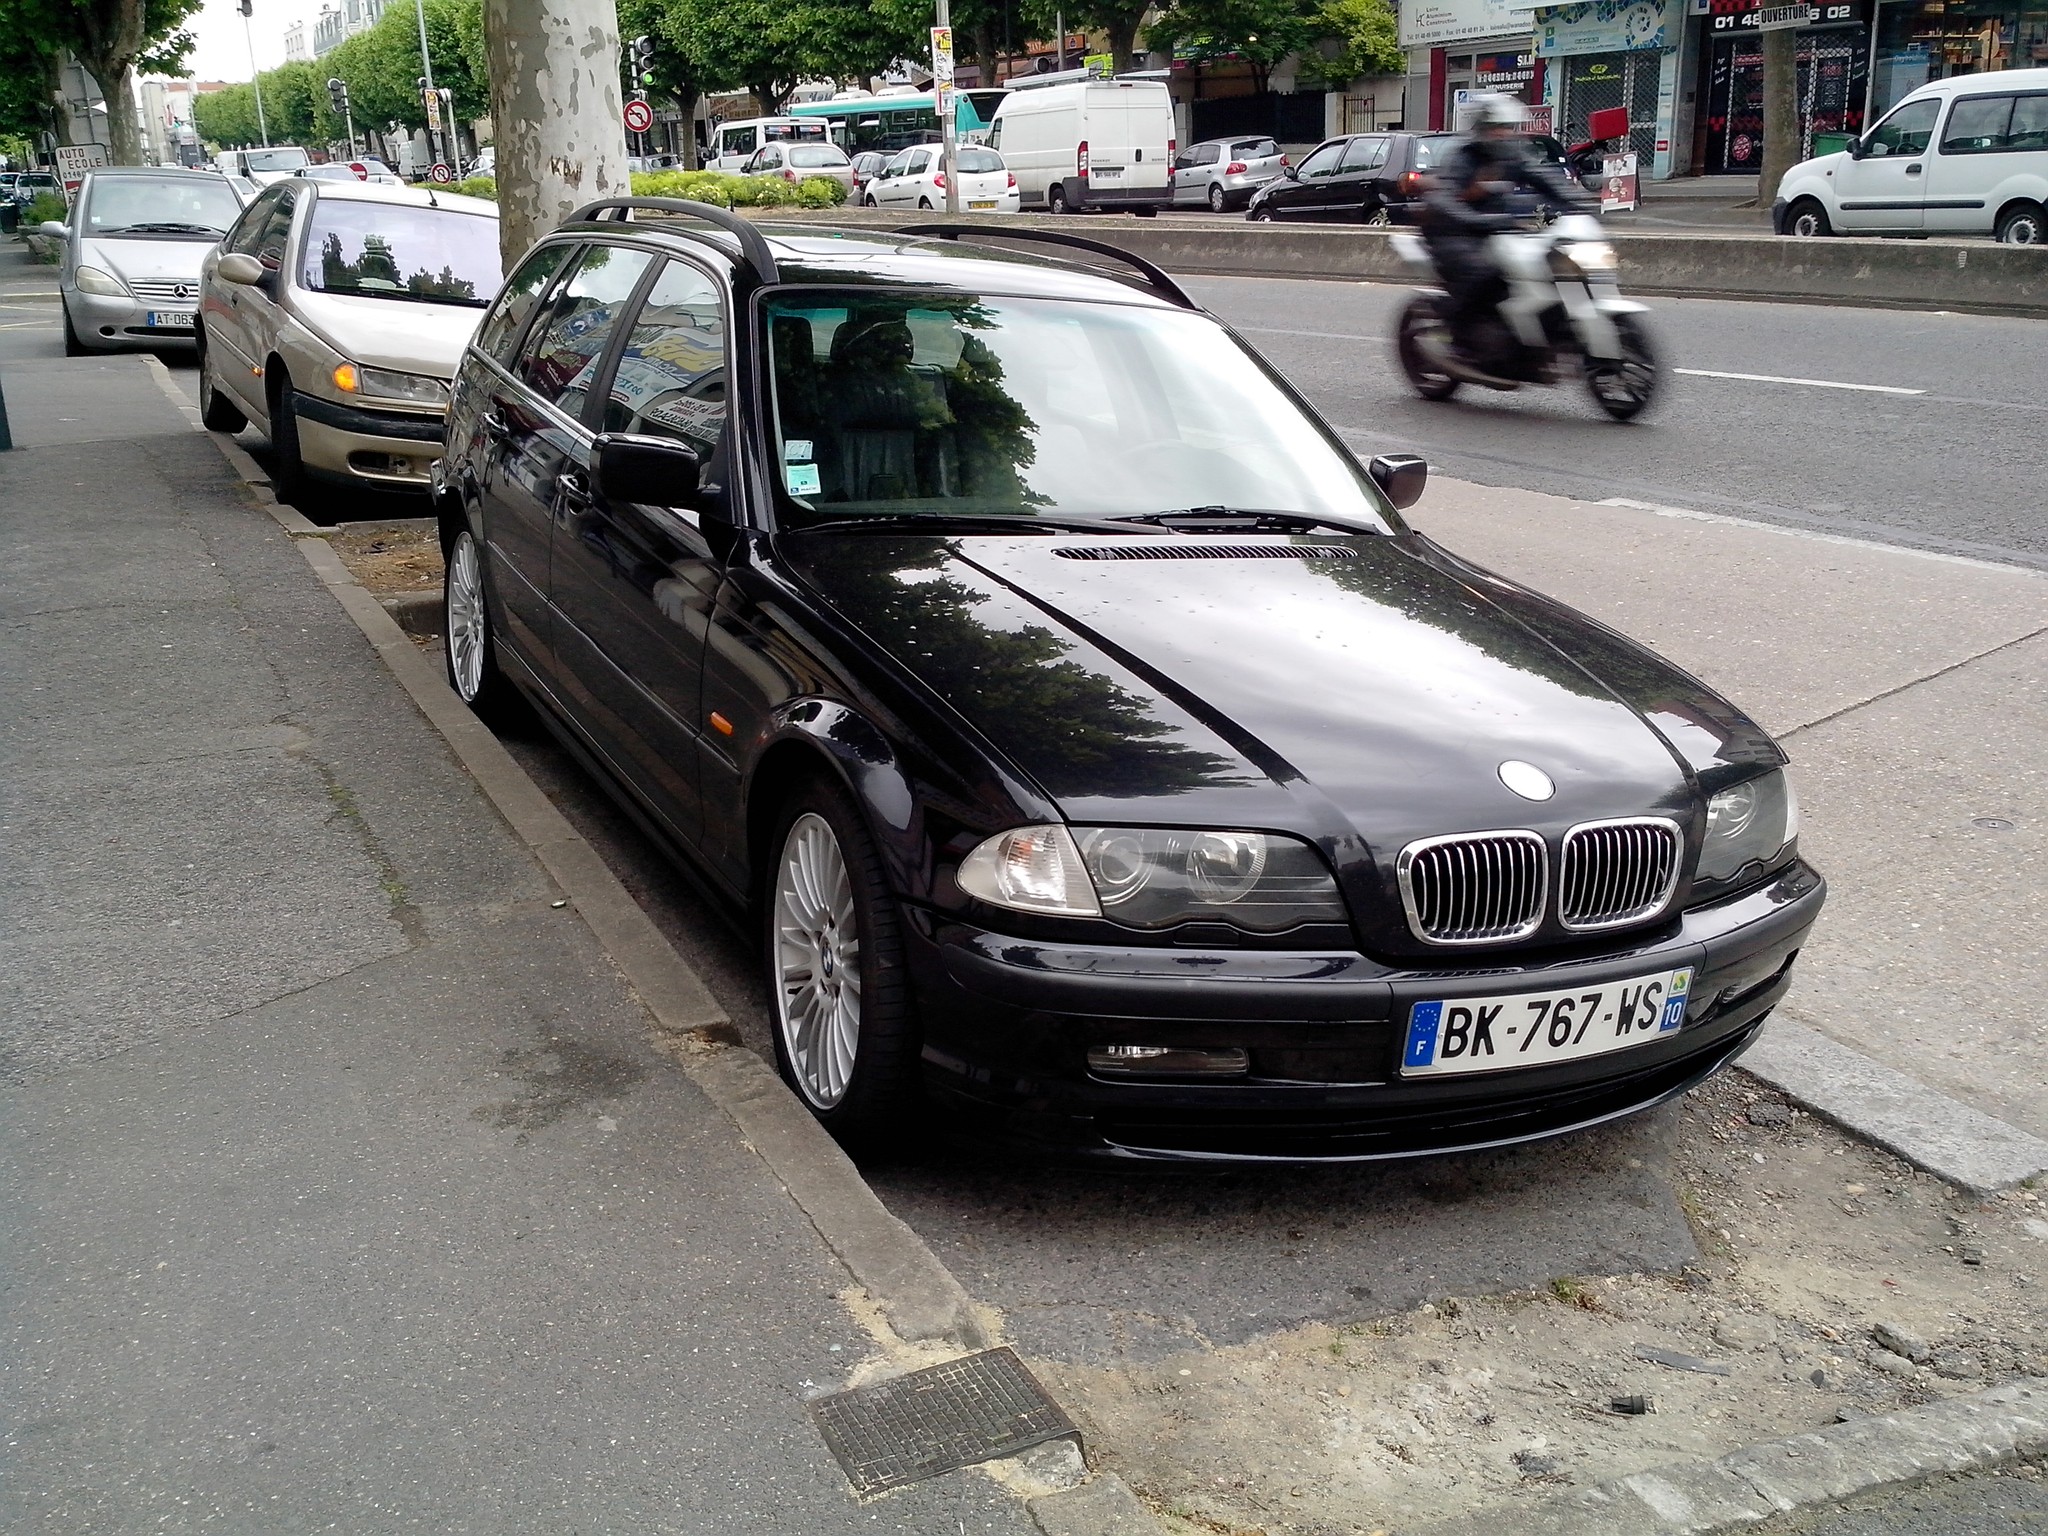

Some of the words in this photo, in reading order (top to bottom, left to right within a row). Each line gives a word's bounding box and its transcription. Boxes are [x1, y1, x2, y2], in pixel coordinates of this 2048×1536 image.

[1715, 16, 1735, 29] 01
[1741, 14, 1760, 26] 48
[1827, 5, 1851, 19] 02
[1761, 4, 1809, 24] OUVERTURE
[59, 148, 85, 160] AUTO
[68, 157, 102, 170] ECOLE
[1415, 1040, 1427, 1056] F
[1440, 981, 1663, 1059] BK-767-WS
[1664, 1001, 1683, 1026] 10
